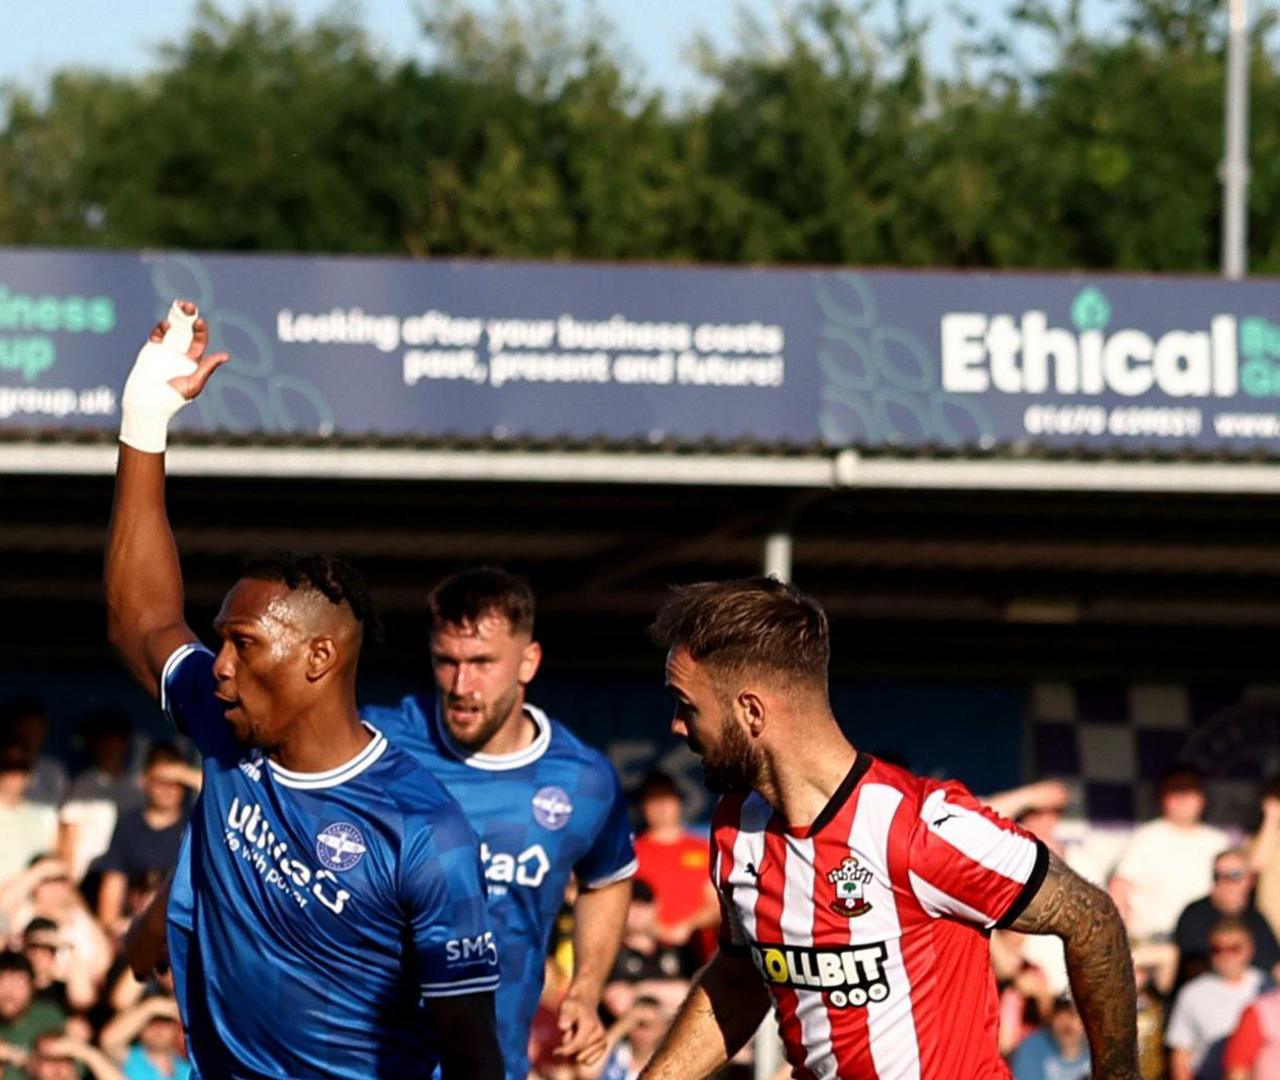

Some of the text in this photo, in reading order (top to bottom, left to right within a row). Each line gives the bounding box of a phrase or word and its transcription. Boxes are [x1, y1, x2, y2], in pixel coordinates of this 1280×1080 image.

[277, 307, 784, 353] Looking after your business costs
[941, 310, 1237, 398] Ethical
